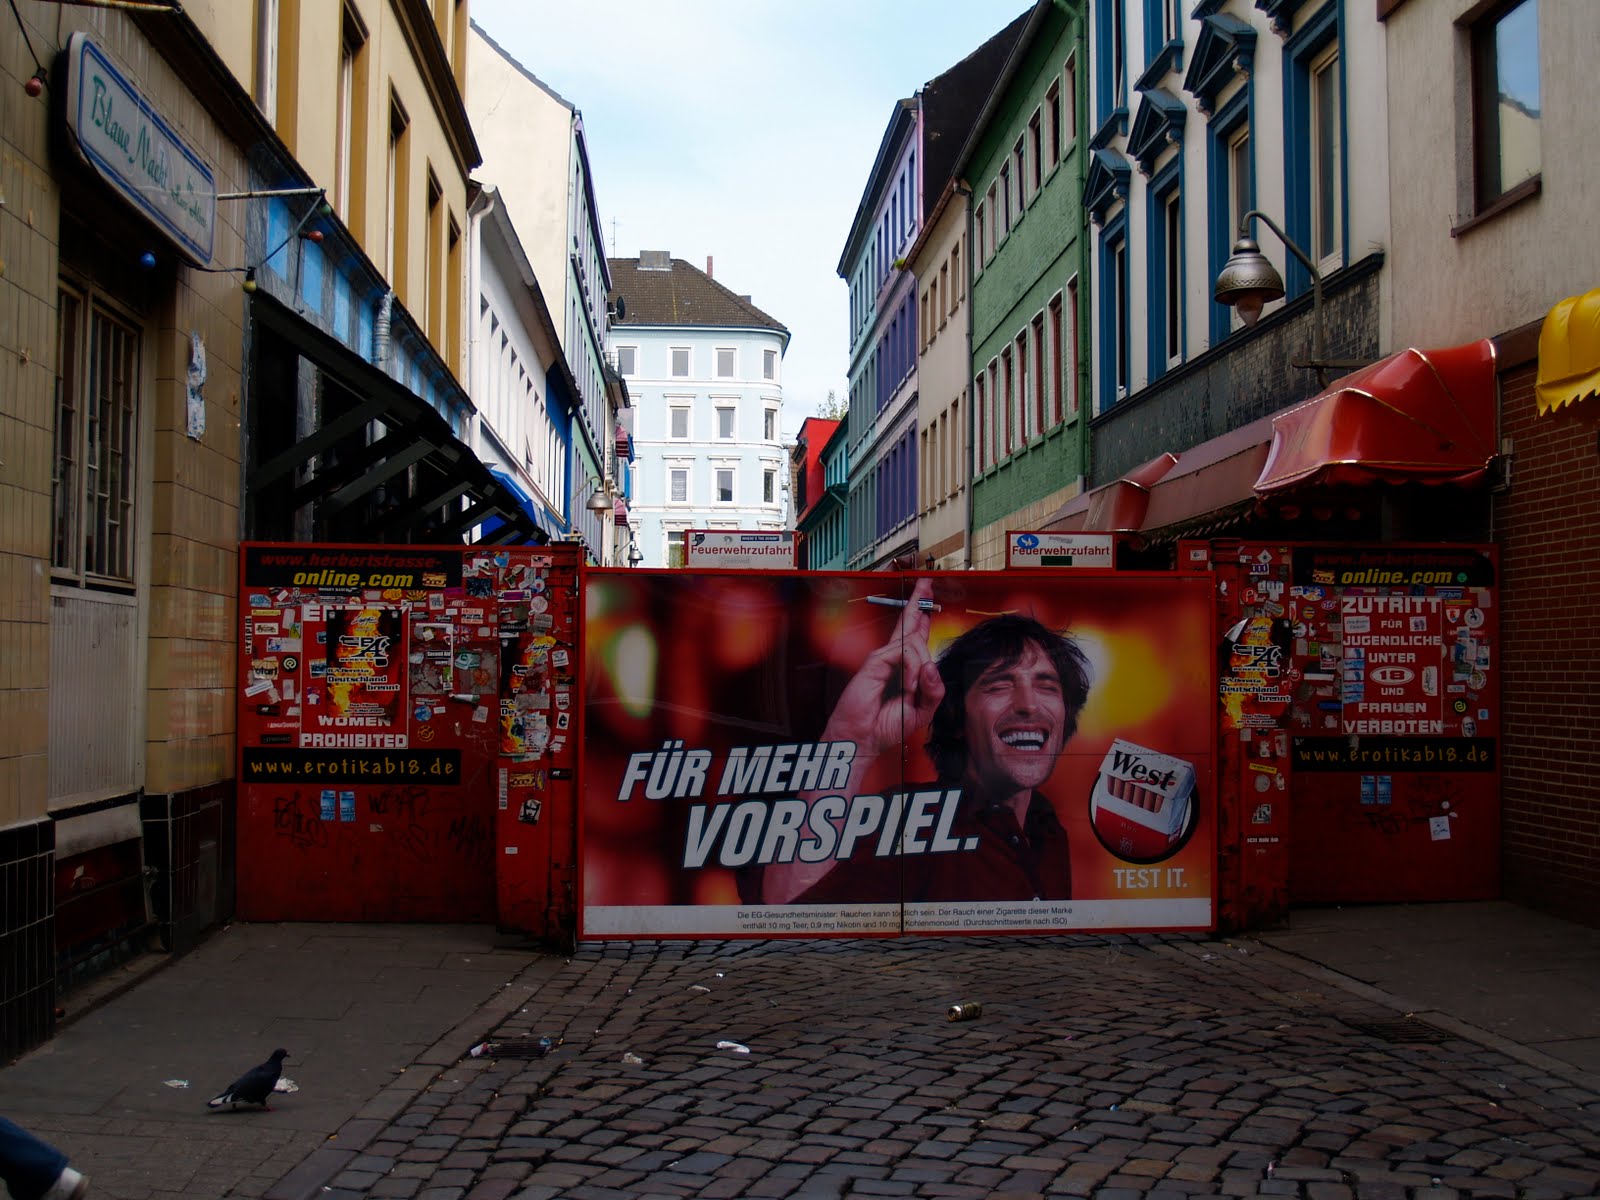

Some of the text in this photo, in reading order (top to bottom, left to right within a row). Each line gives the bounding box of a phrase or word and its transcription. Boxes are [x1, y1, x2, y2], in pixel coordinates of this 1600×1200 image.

[91, 75, 168, 190] Blaue Nacht
[691, 545, 792, 555] Feuerwehrzufahrt
[1012, 546, 1110, 555] Feuerwehrzufahrt
[293, 569, 414, 587] online.com
[1340, 568, 1454, 585] online.com
[1343, 597, 1442, 613] ZUTRITT
[1380, 619, 1403, 629] FÜR
[1343, 635, 1442, 646] JUGENDLICHE
[1368, 652, 1416, 663] UNTER
[1380, 670, 1405, 681] 18
[1358, 702, 1427, 713] FRAUEN
[318, 715, 391, 727] WOMEN
[1343, 720, 1443, 733] VERBOTEN
[301, 733, 408, 747] PROHIBITED
[1300, 745, 1489, 763] www.erotikab18.de
[251, 756, 455, 775] www.erotikab18.de
[617, 739, 857, 801] FÜR MEHR
[1112, 750, 1176, 791] West
[681, 789, 981, 870] VORSPIEL.
[1113, 867, 1188, 889] TEST IT.
[840, 910, 871, 918] Rauchen
[873, 910, 890, 918] kann
[953, 908, 975, 916] Rauch
[996, 907, 1026, 916] Zigarette
[837, 921, 861, 929] Nikotin
[889, 922, 901, 930] mg
[963, 918, 1032, 926] (Durchschnittswerte
[1033, 917, 1050, 925] nach
[1052, 917, 1068, 925] ISO)
